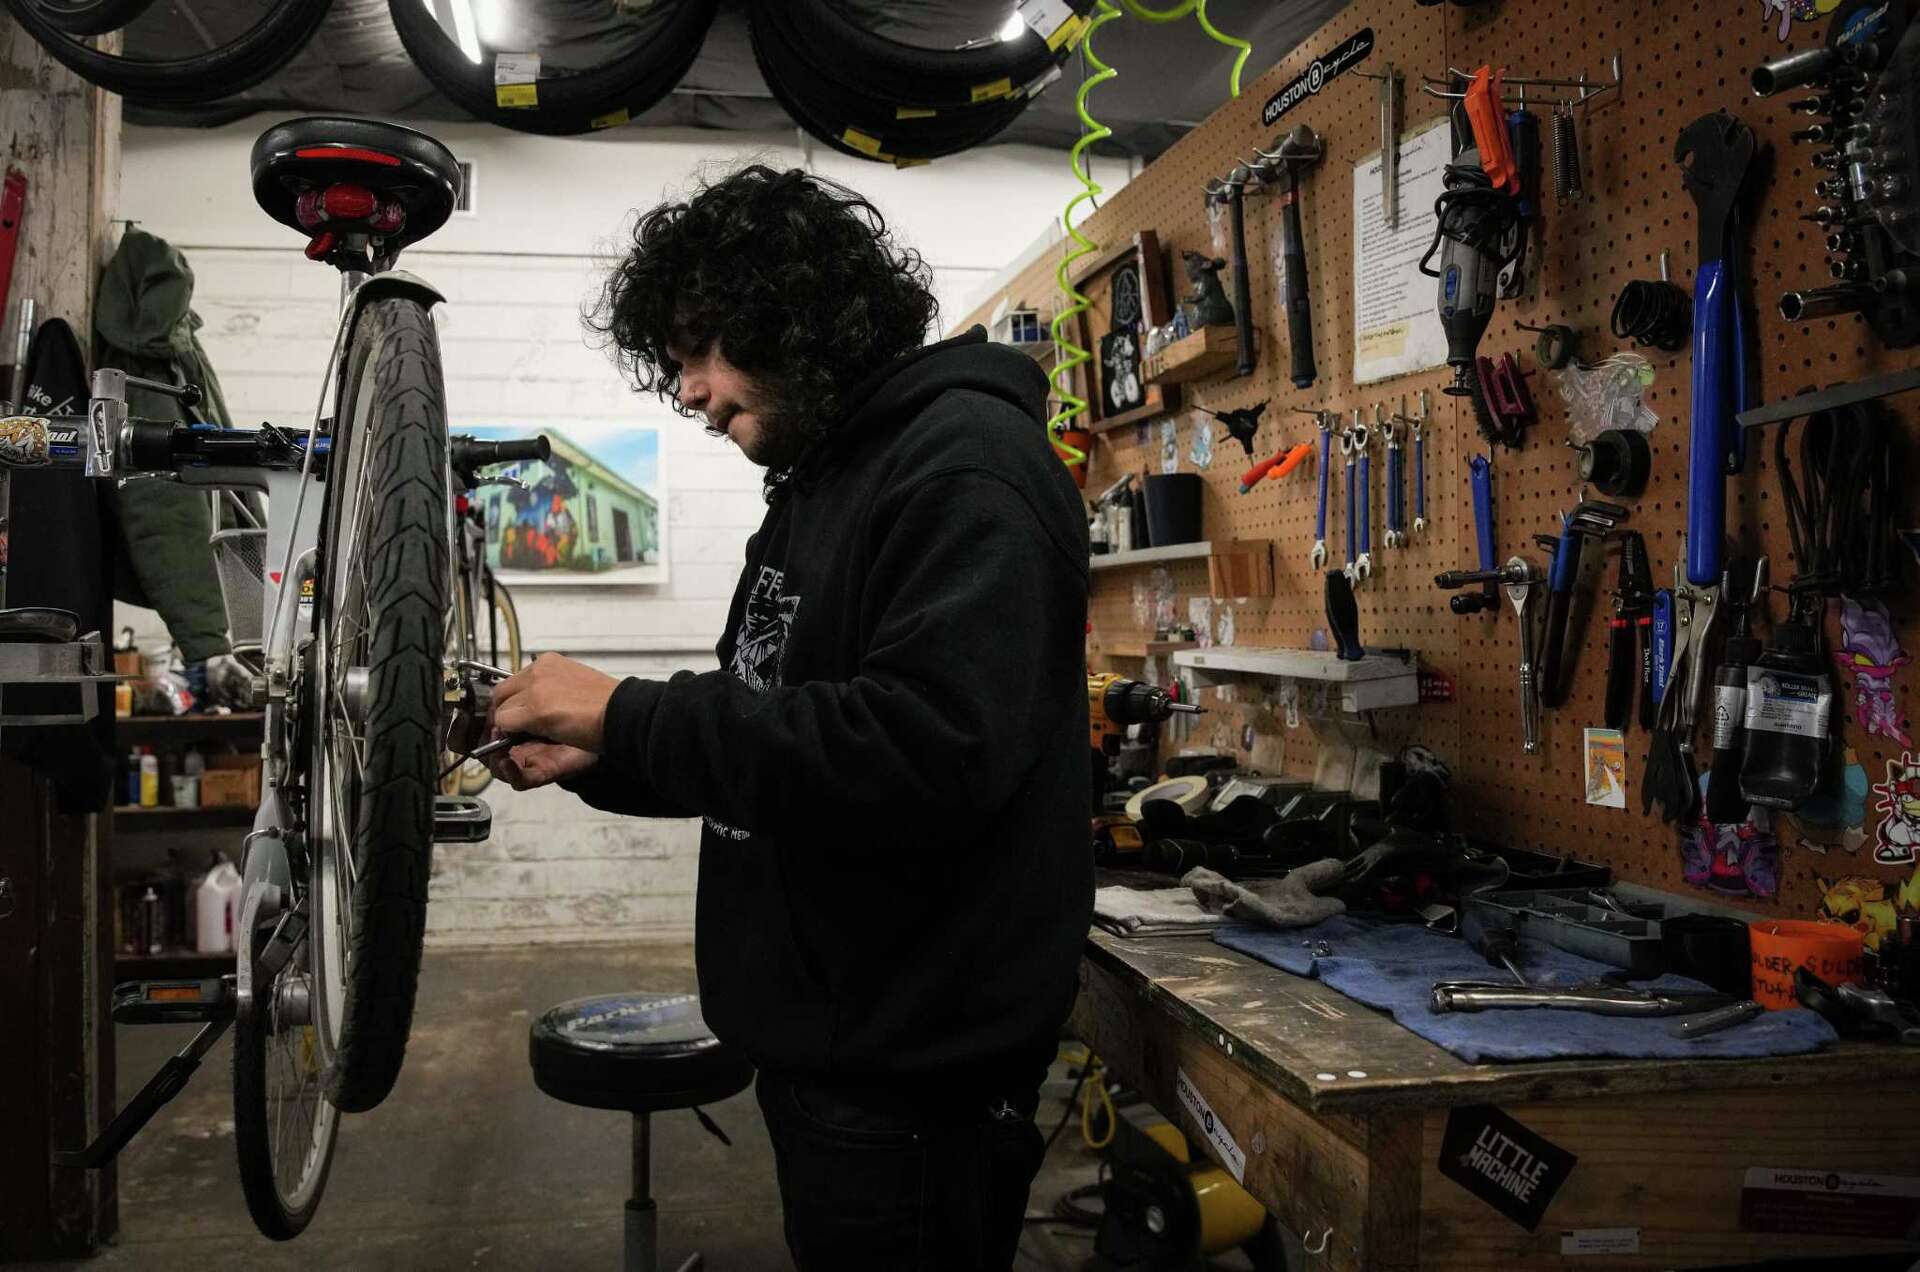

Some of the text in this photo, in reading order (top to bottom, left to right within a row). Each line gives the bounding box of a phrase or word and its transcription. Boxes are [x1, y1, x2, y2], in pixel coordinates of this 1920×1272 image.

[1265, 79, 1308, 122] HOUSTON
[1469, 1145, 1537, 1204] MACHINE
[1475, 1124, 1549, 1186] LITTLE
[1774, 1174, 1824, 1185] HOUSTON
